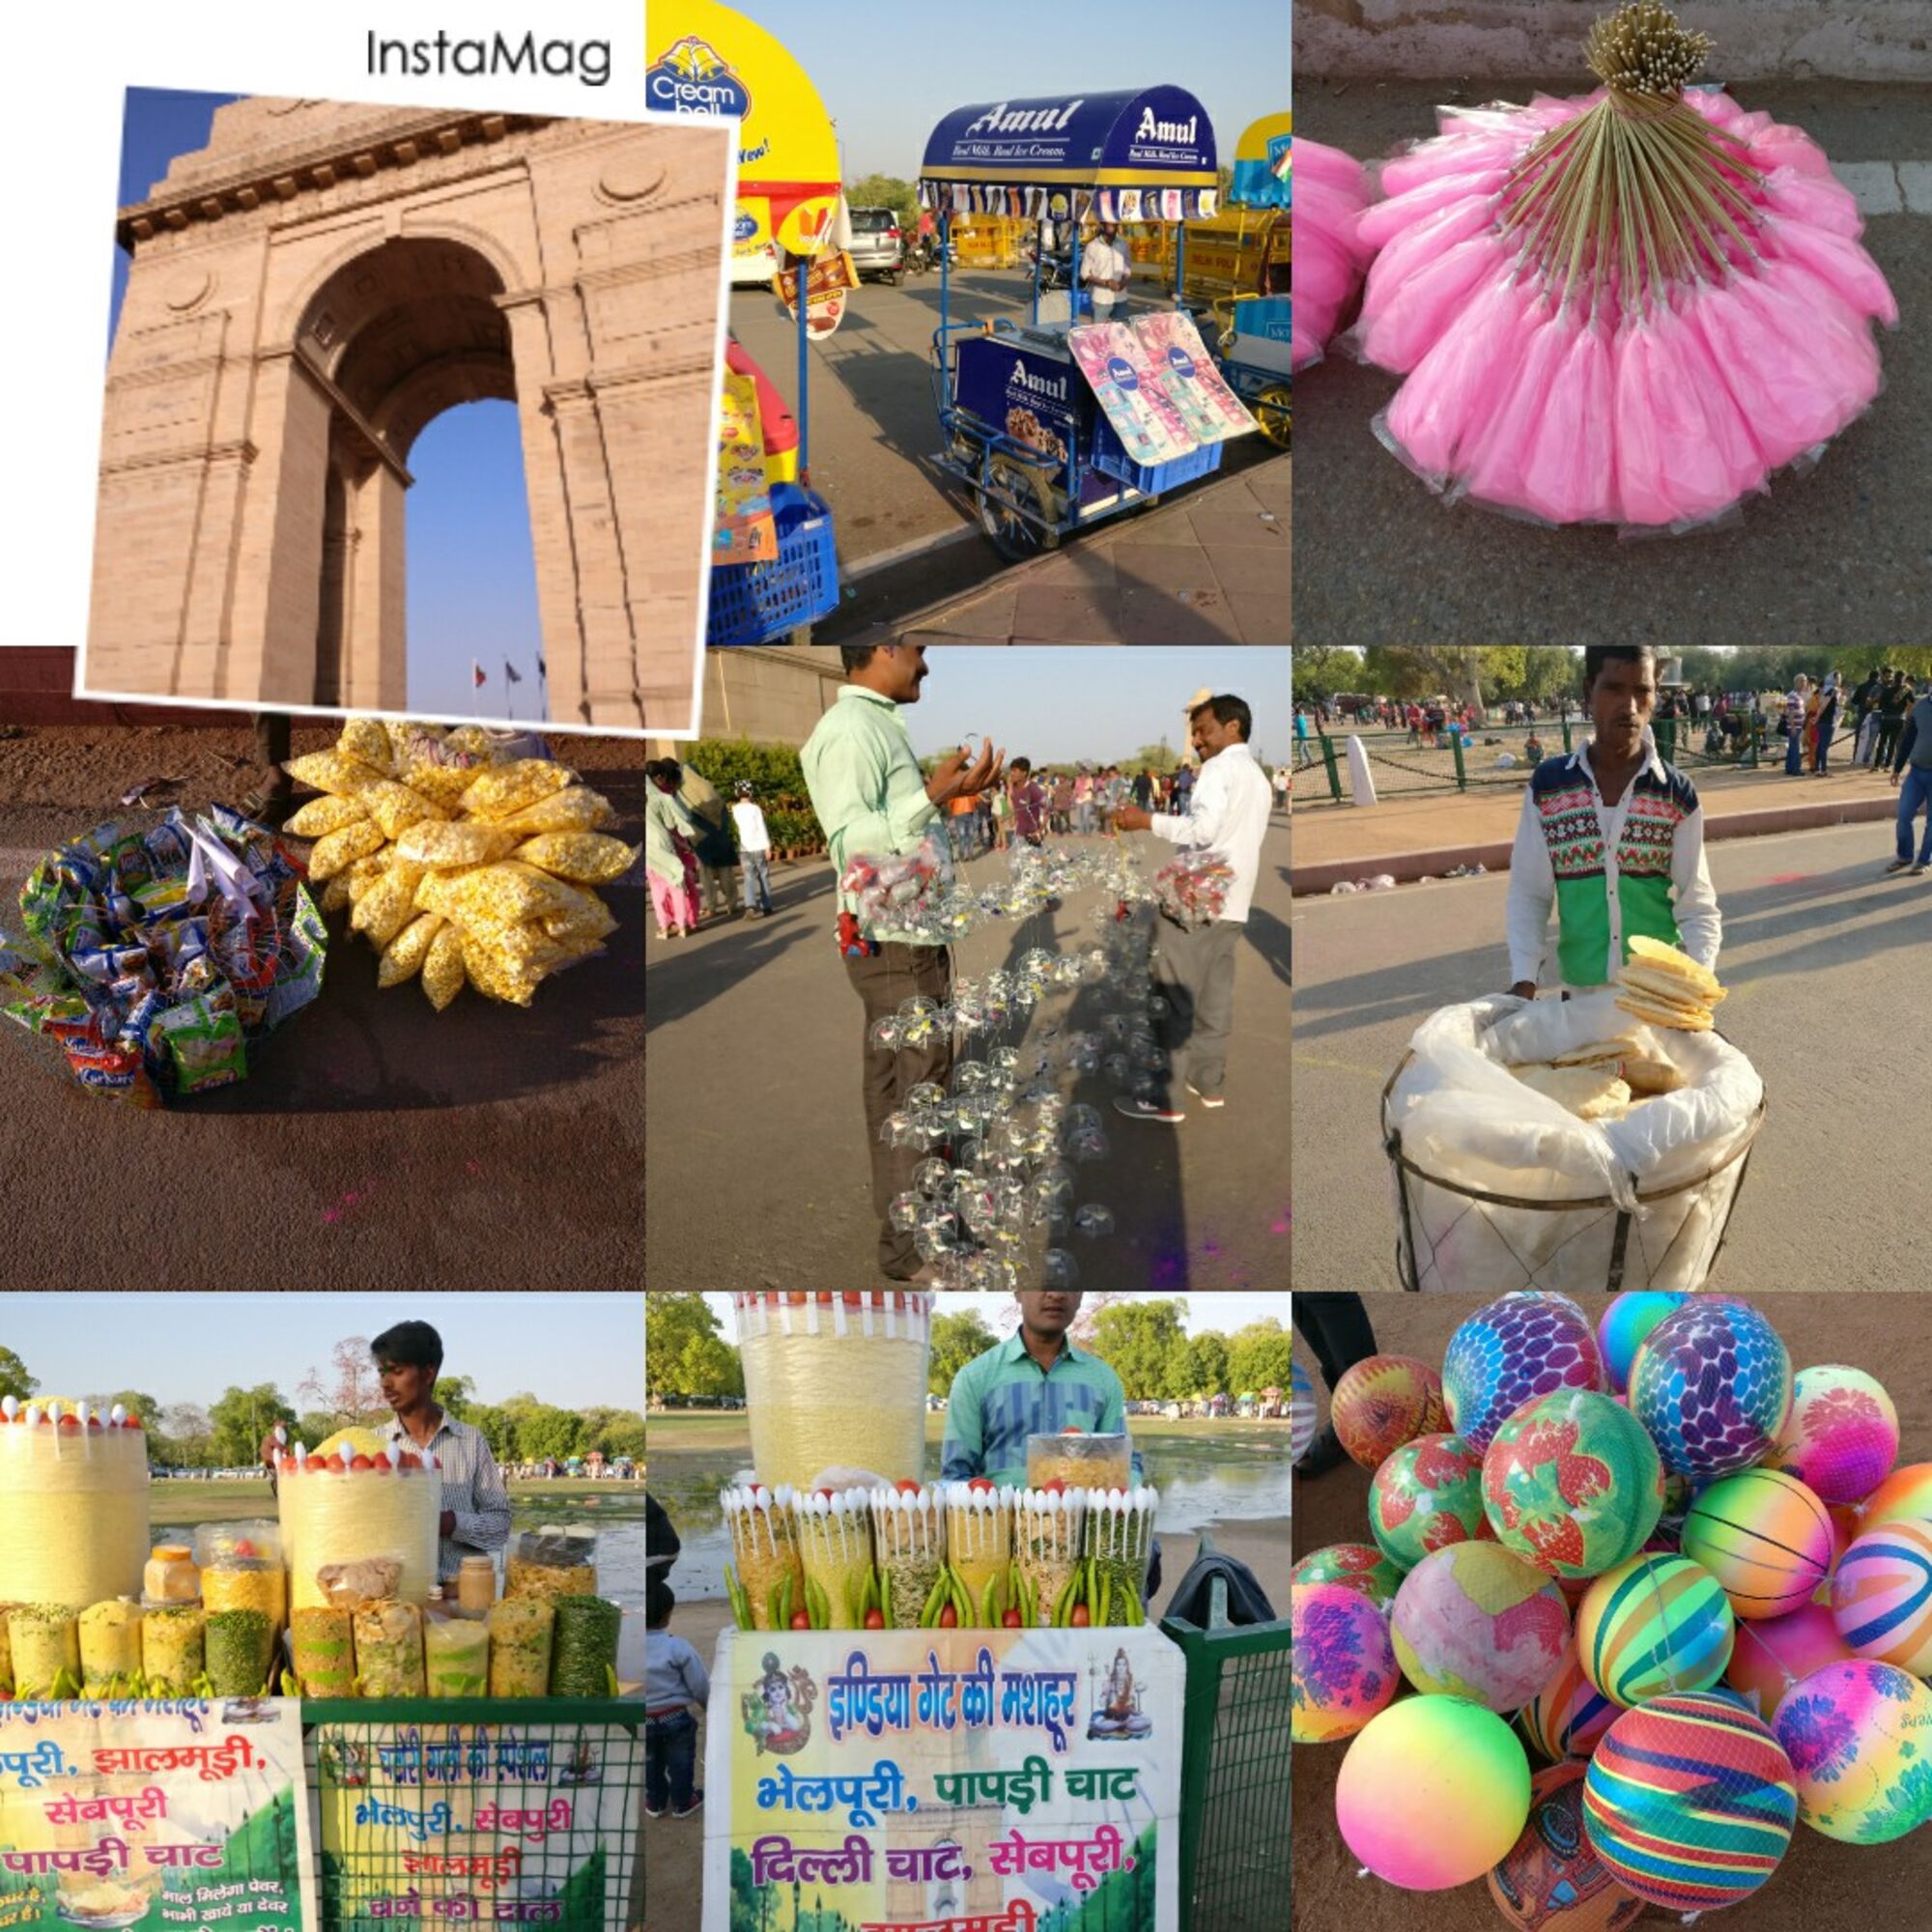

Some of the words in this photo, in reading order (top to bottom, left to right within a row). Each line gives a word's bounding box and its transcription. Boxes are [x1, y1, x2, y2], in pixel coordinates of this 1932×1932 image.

[653, 76, 734, 104] Cream
[966, 99, 1084, 137] Amul
[1135, 106, 1197, 144] Amul
[1009, 358, 1067, 401] Amul
[828, 1650, 910, 1740] इण्डिया
[918, 1651, 956, 1732] गेट
[961, 1647, 995, 1729] की
[1002, 1671, 1076, 1750] मशहूर
[0, 1741, 77, 1787] पूरी,
[92, 1735, 267, 1780] झालमूड़ी,
[43, 1786, 169, 1831] सेबपूरी
[757, 1760, 917, 1827] भेलपूरी,
[935, 1755, 1053, 1814] पापड़ी
[1065, 1768, 1139, 1802] चाट
[2, 1837, 130, 1877] पापड़ी
[144, 1843, 224, 1867] चाट
[751, 1835, 874, 1885] दिल्ली
[886, 1845, 973, 1884] चाट,
[990, 1824, 1135, 1889] सेबपूरी,
